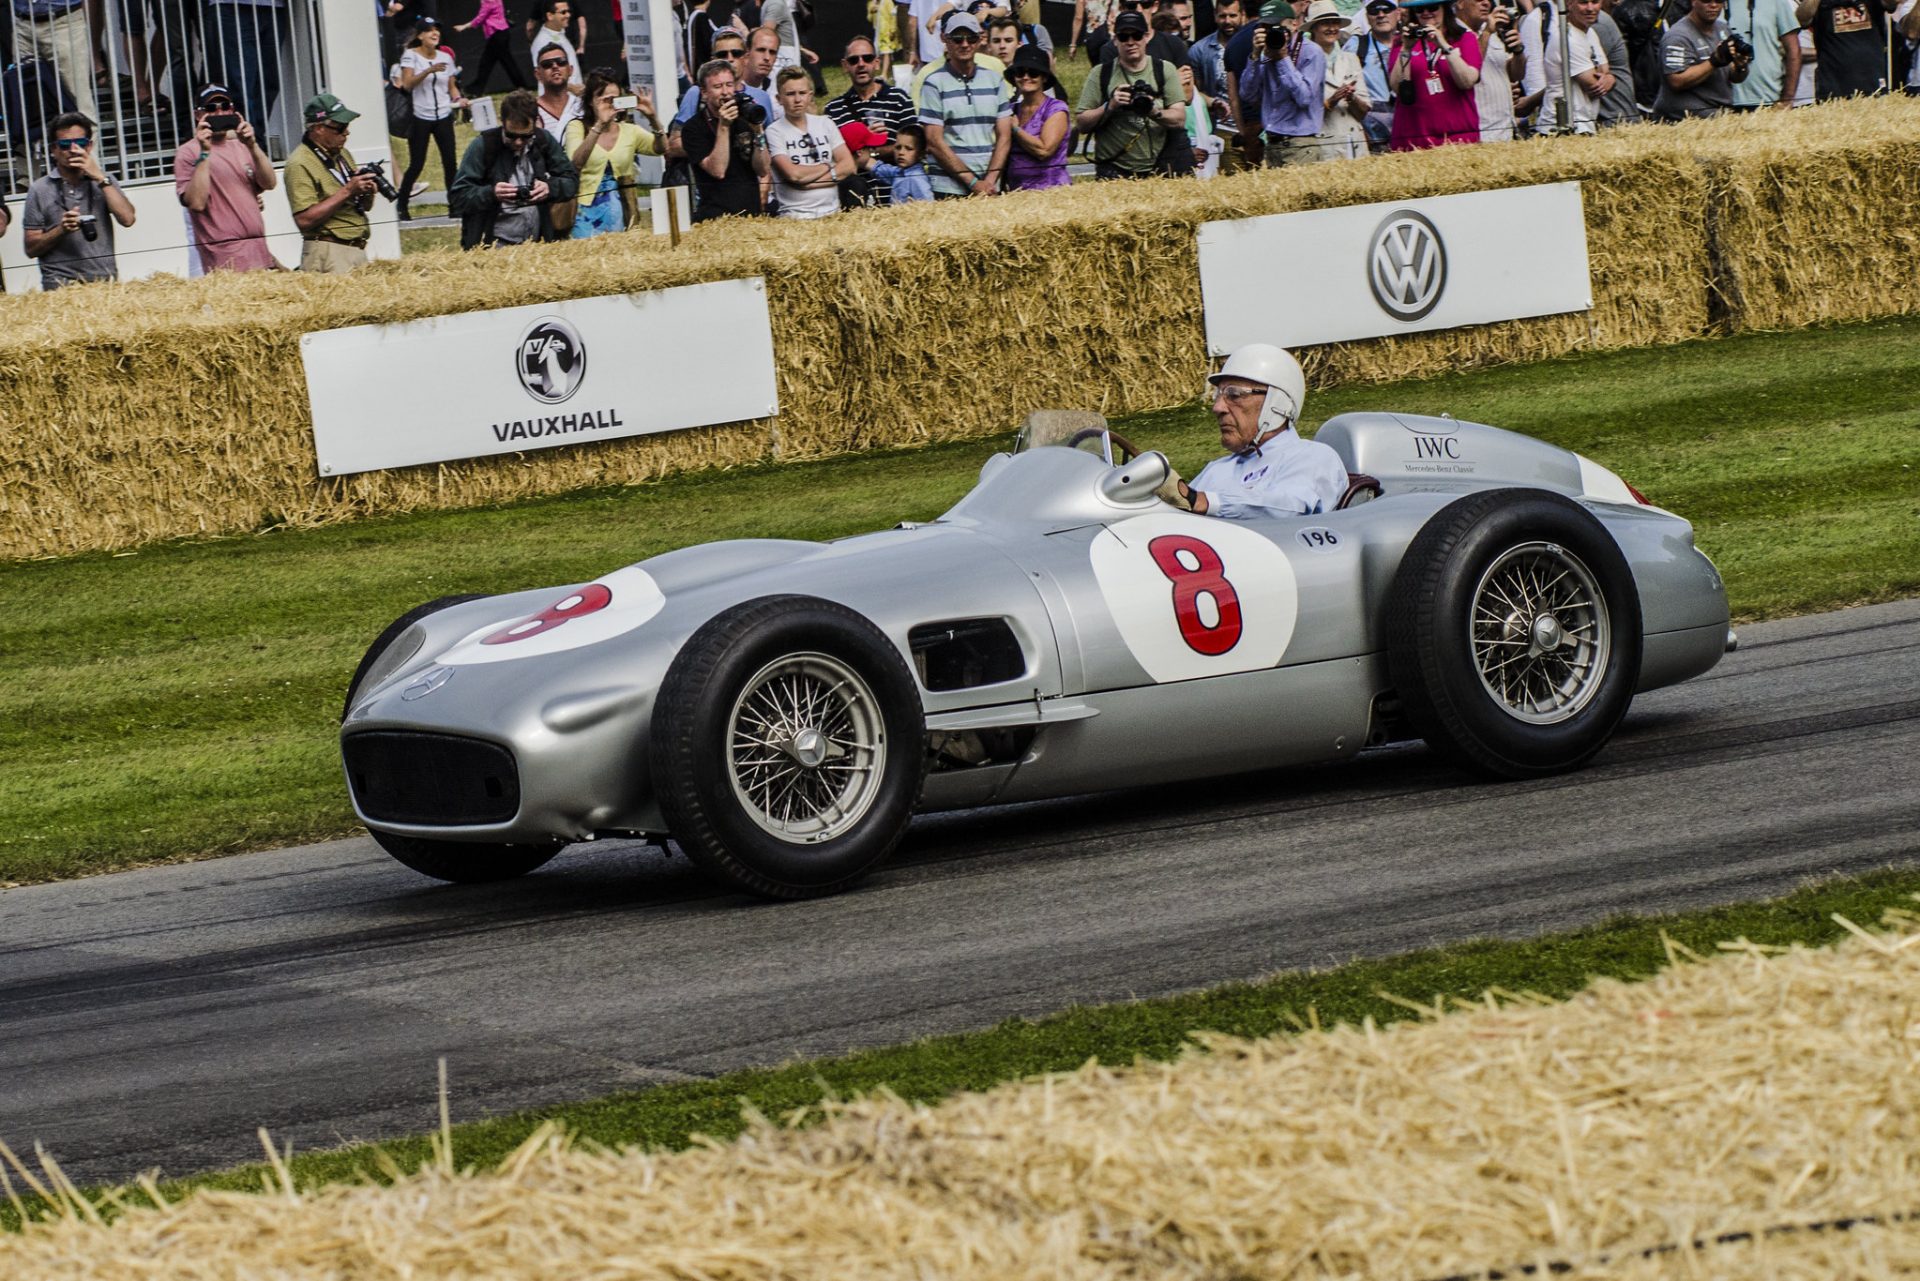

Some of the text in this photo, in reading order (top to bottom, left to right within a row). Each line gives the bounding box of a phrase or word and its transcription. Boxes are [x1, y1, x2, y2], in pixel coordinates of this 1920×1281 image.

[493, 409, 623, 442] VAUXHALL
[1414, 437, 1460, 459] IWC
[1405, 465, 1452, 473] Mercedes-Benz
[1302, 531, 1338, 547] 196
[1148, 534, 1243, 657] 8
[480, 583, 613, 646] 8
